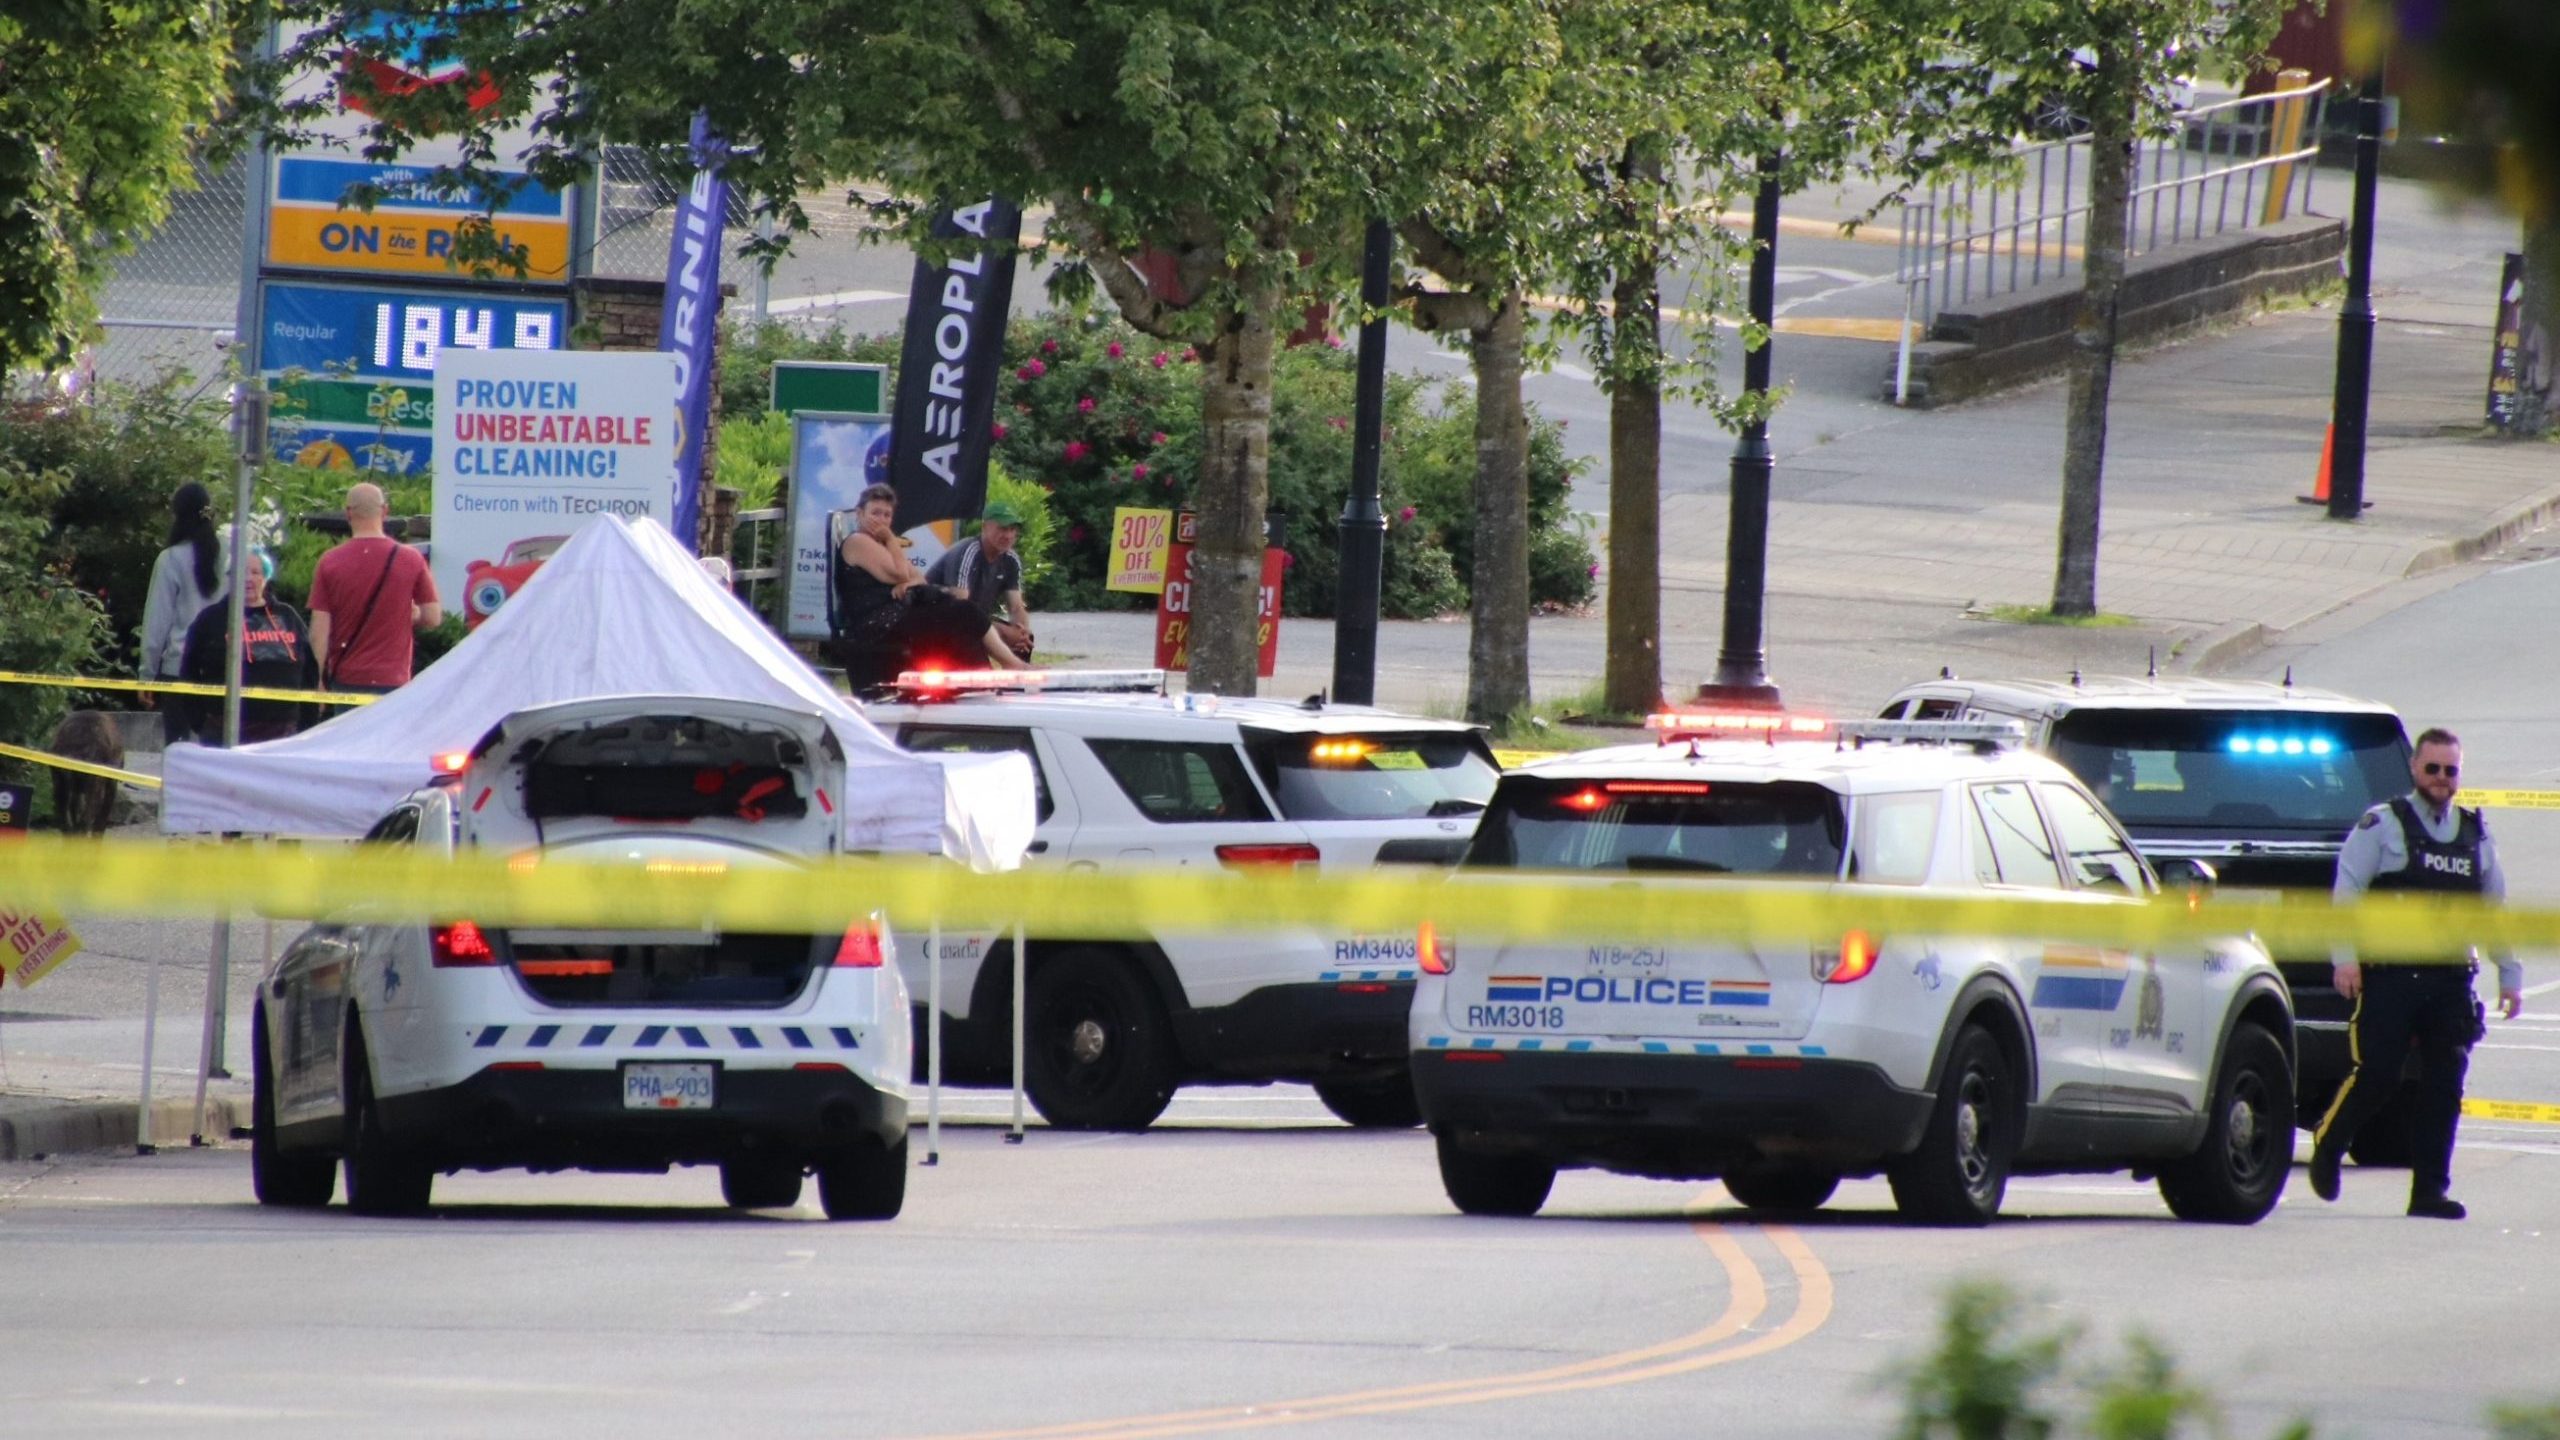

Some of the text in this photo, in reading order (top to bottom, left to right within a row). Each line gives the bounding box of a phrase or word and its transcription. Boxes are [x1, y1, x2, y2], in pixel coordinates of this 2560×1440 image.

[382, 168, 413, 181] with
[319, 223, 379, 254] ON
[388, 232, 417, 250] the
[273, 321, 337, 342] Regular
[456, 379, 576, 409] PROVEN
[455, 413, 651, 445] UNBEATABLE
[454, 447, 616, 478] CLEANING!
[453, 494, 650, 517] Chevron with TECHRON
[1119, 514, 1166, 550] 30%
[1125, 551, 1152, 571] OFF
[2424, 852, 2472, 876] POLICE
[11, 915, 45, 955] OFF
[15, 928, 69, 980] EVERYTHING
[1335, 939, 1416, 962] RM3403
[1544, 976, 1706, 1006] POLICE
[1468, 1006, 1564, 1029] RM3018
